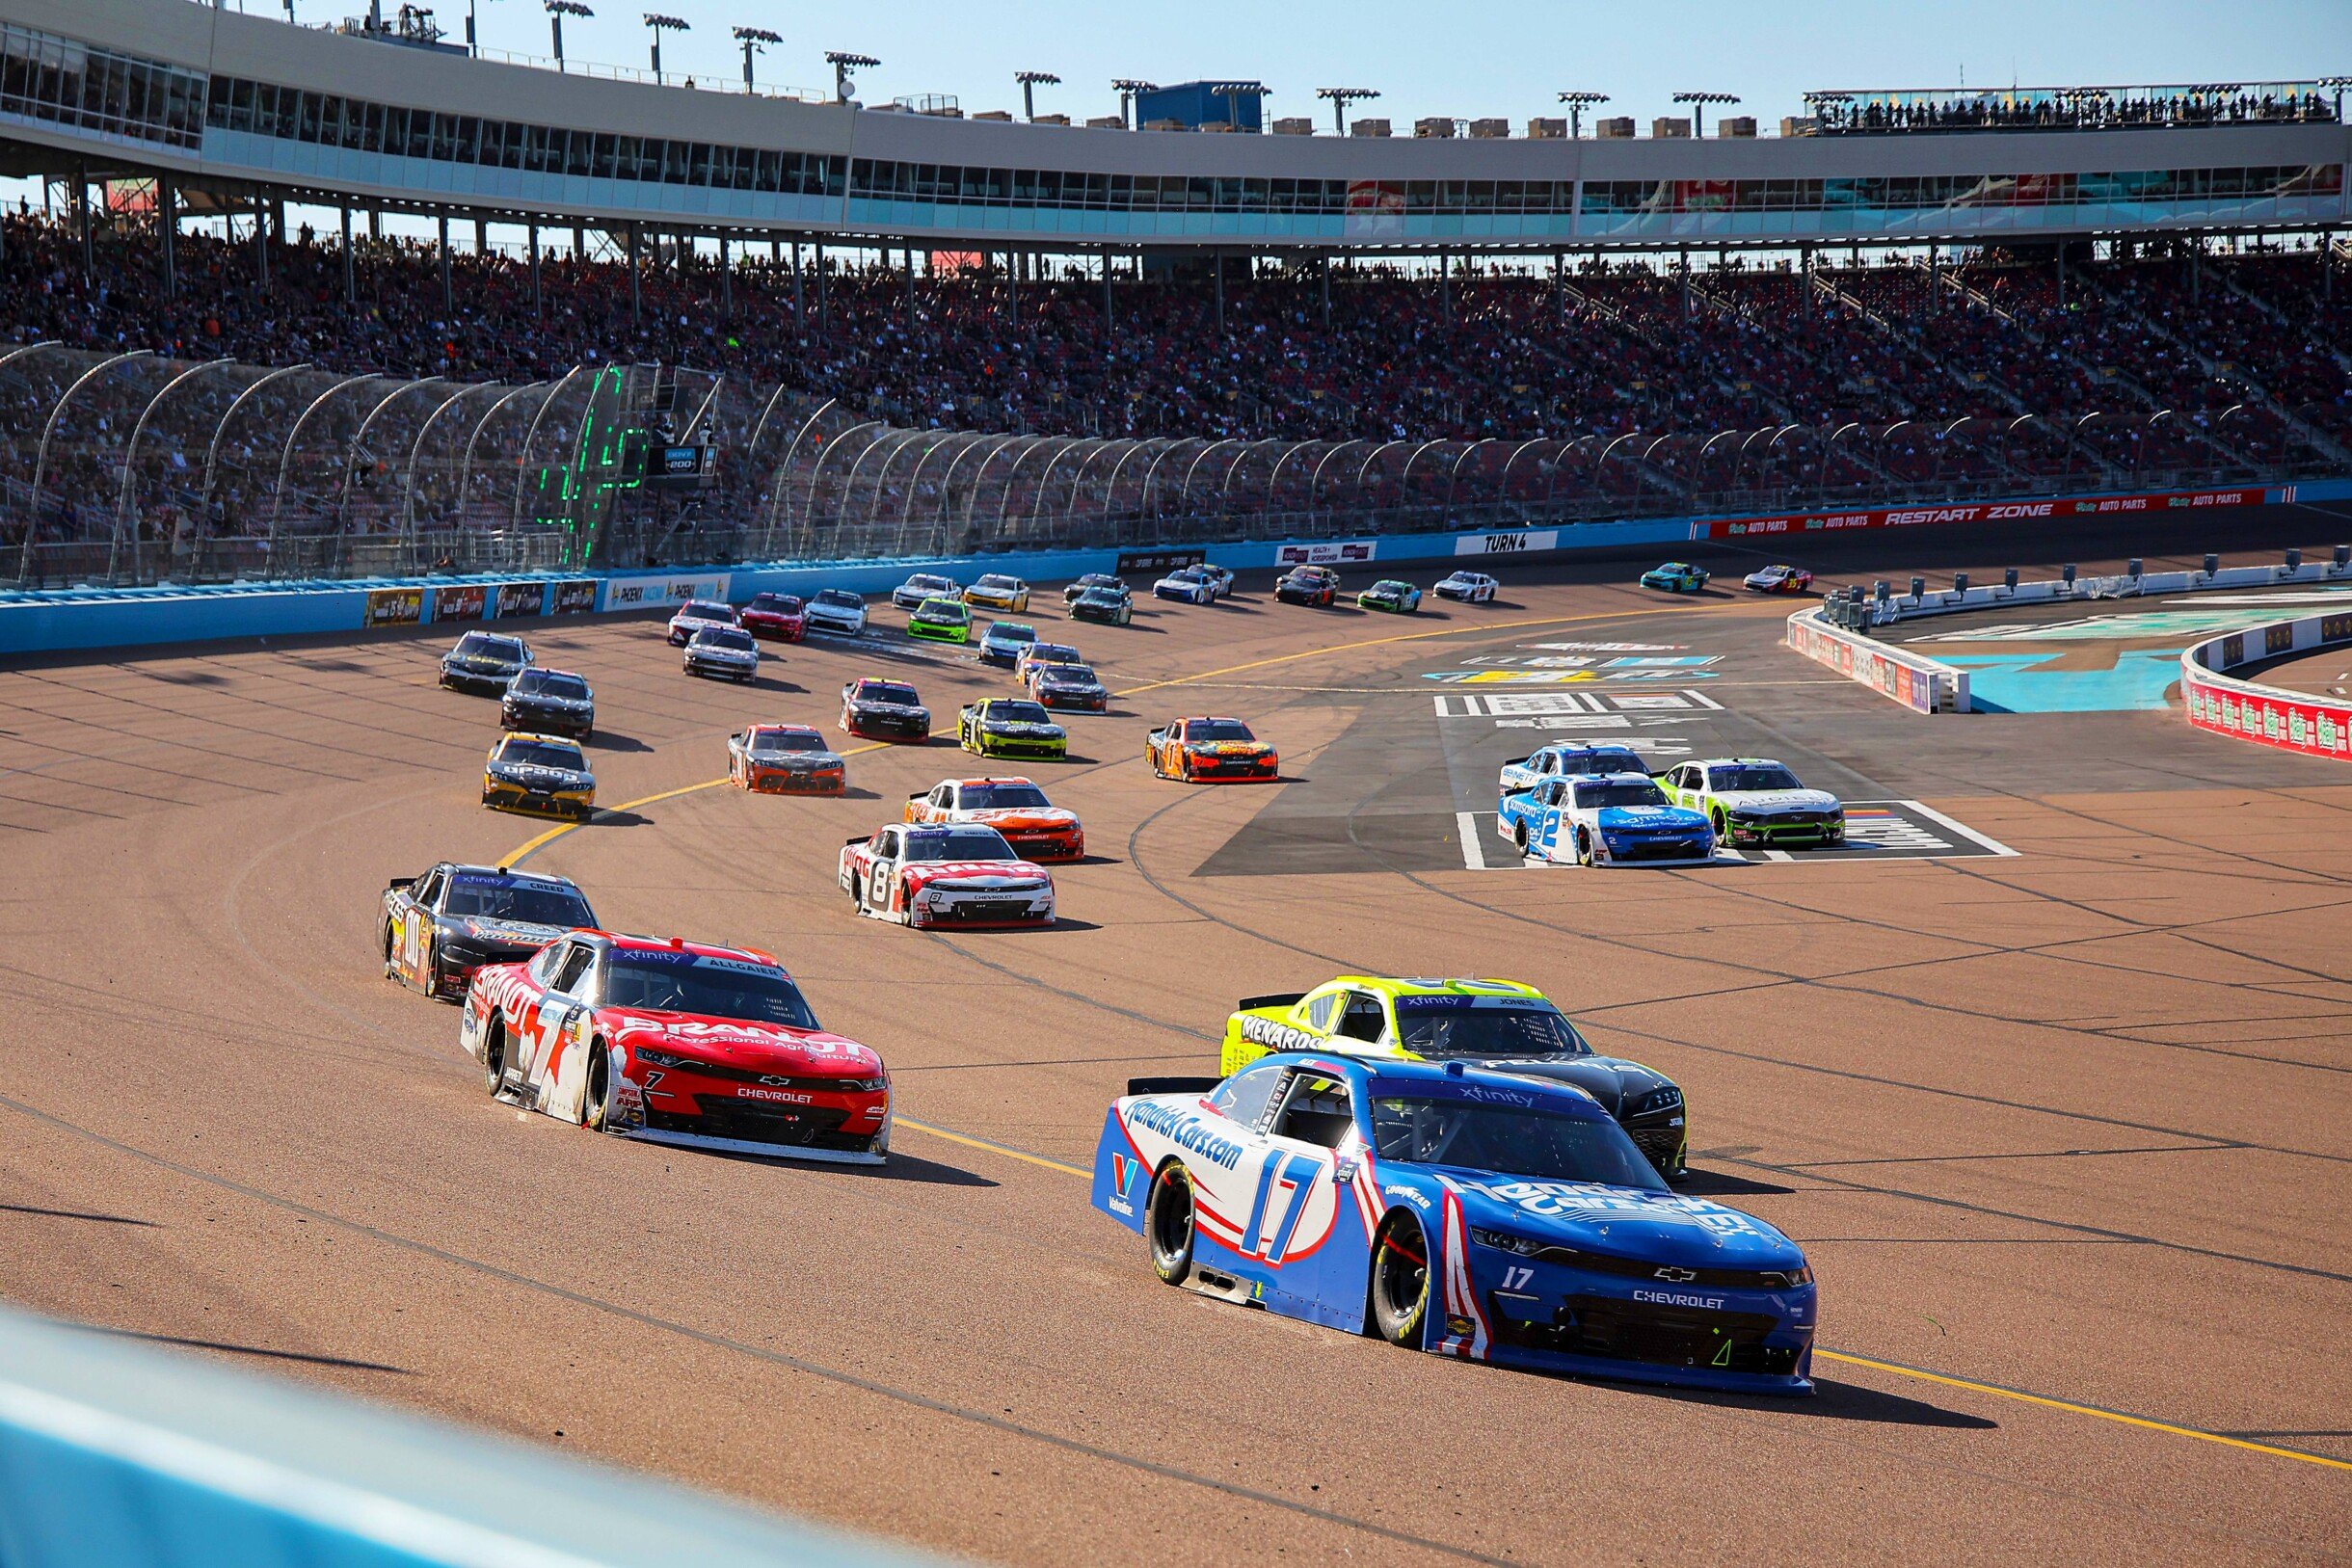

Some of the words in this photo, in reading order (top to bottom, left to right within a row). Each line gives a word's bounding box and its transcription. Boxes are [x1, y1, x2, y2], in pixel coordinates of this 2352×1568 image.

[2099, 500, 2120, 511] AUTO
[2122, 499, 2147, 510] PARTS
[2193, 495, 2213, 506] AUTO
[2215, 493, 2242, 504] PARTS
[1825, 517, 1843, 528] AUTO
[1845, 516, 1868, 526] PARTS
[1884, 508, 1980, 525] RESTART
[1987, 504, 2054, 518] ZONE
[1748, 521, 1765, 533] AUTO
[1766, 520, 1788, 532] PARTS
[1484, 533, 1517, 552] TURN
[1518, 533, 1527, 549] 4
[620, 586, 645, 602] PHOENIX
[675, 583, 696, 599] PHOENIX
[1502, 768, 1535, 782] BENNETT
[1510, 799, 1537, 817] samsara
[1542, 808, 1562, 847] 2
[462, 875, 505, 887] xfinity
[530, 882, 564, 892] CREED
[870, 863, 891, 904] 8
[929, 892, 942, 903] 8
[405, 909, 422, 969] 00
[623, 948, 681, 964] xfinity
[709, 958, 778, 976] ALLGAIER
[473, 965, 543, 1029] BRANDT
[1407, 995, 1459, 1007] xfinity
[1499, 998, 1535, 1007] JONES
[615, 1016, 872, 1060] BRANDT
[663, 1033, 769, 1046] Professional
[1242, 1015, 1323, 1050] MENARDS
[528, 998, 571, 1086] 7
[644, 1070, 665, 1090] 7
[618, 1087, 640, 1098] SIMPSON
[737, 1087, 813, 1104] CHEVROLET
[1459, 1086, 1534, 1107] xfinity
[616, 1098, 642, 1108] ARP
[1385, 1184, 1431, 1209] GOODYEAR
[1109, 1195, 1134, 1217] Valvoline
[1238, 1147, 1328, 1265] 17
[1501, 1265, 1535, 1290] 17
[1633, 1289, 1724, 1310] CHEVROLET
